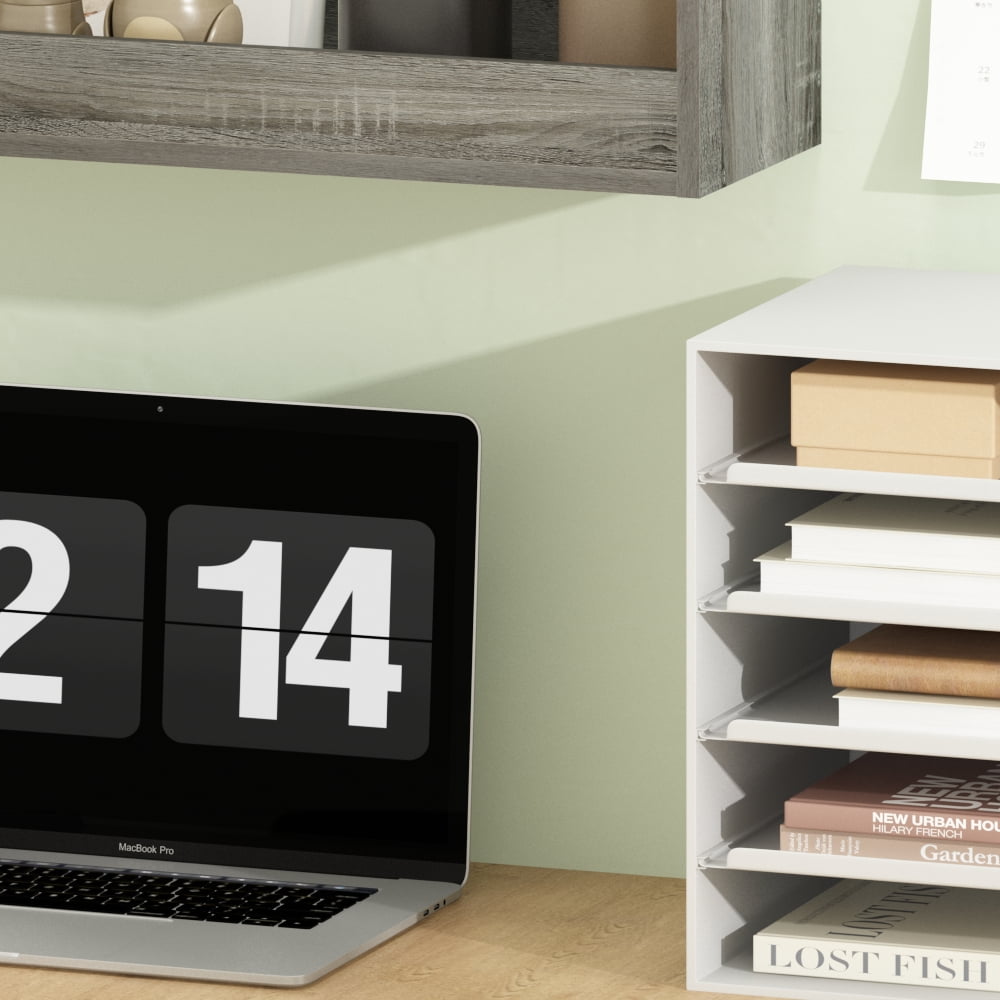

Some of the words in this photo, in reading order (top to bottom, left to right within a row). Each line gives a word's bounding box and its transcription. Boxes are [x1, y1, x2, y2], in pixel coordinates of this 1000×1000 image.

[198, 540, 402, 728] 14
[881, 774, 967, 807] NEW
[872, 812, 908, 825] NEW
[912, 815, 966, 829] URBAN
[872, 824, 913, 835] HILARY
[916, 828, 963, 839] FRENCH
[118, 842, 157, 854] MacBook
[159, 846, 174, 855] Pro
[828, 904, 916, 938] LOST
[768, 944, 880, 974] LOST
[894, 954, 989, 983] FISH
